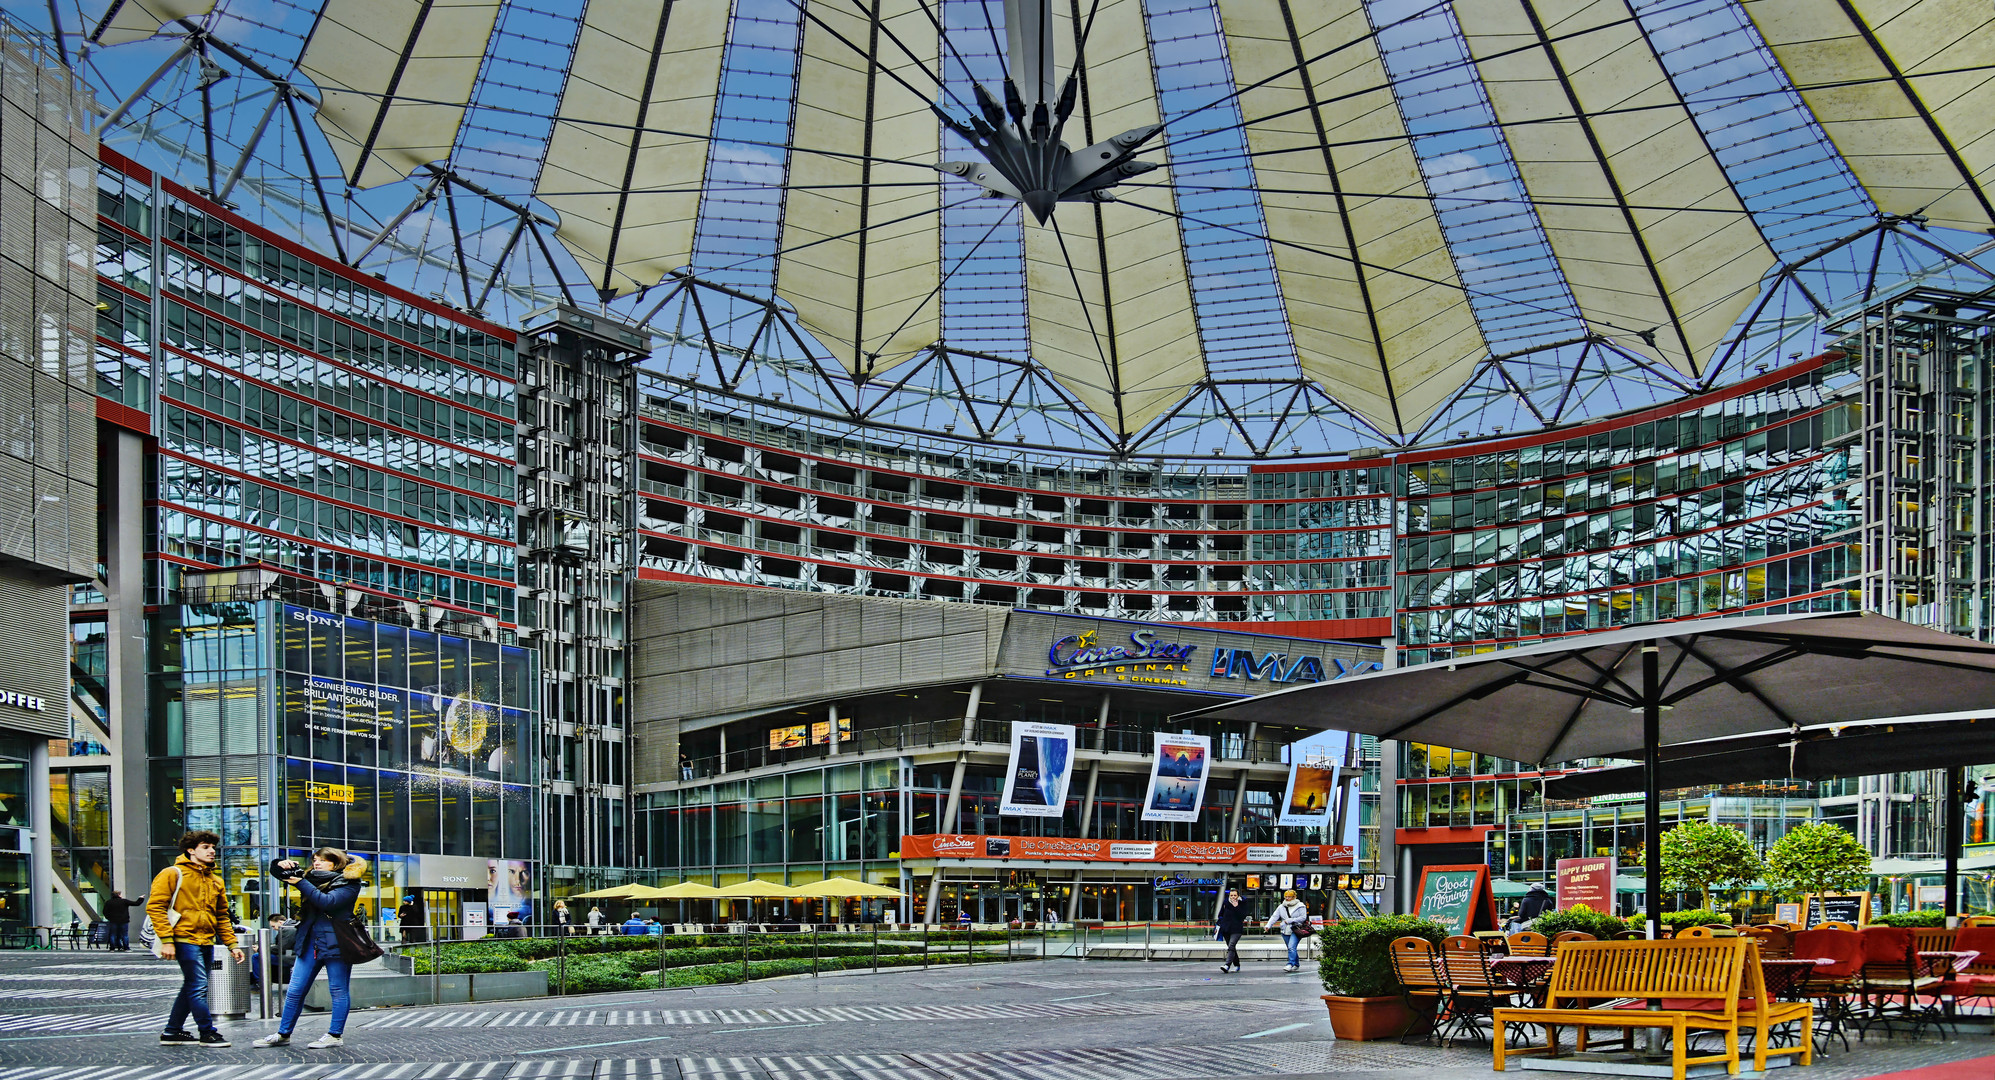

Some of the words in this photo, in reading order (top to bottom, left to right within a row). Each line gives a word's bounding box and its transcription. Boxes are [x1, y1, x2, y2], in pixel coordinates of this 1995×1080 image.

[294, 611, 343, 628] SONY
[1050, 629, 1198, 665] CineStar
[1065, 664, 1189, 679] ORIGINAL
[1210, 648, 1378, 683] IMAX
[1132, 676, 1188, 685] CINEMAS
[0, 690, 46, 711] OFFEE
[1299, 759, 1332, 770] LOGAN
[308, 786, 328, 796] 4K
[331, 789, 352, 798] HDR
[1594, 792, 1646, 801] LINDENBRA
[933, 836, 975, 850] CineStar
[1021, 840, 1035, 849] Die
[1038, 841, 1100, 851] CineStarCARD
[1171, 845, 1236, 855] CineStarCARD
[1560, 866, 1581, 876] HAPPY
[1581, 863, 1605, 873] HOUR
[1154, 874, 1197, 888] CineStar
[1197, 877, 1224, 885] IMAX
[1436, 875, 1469, 893] Good
[1570, 873, 1590, 883] DAYS
